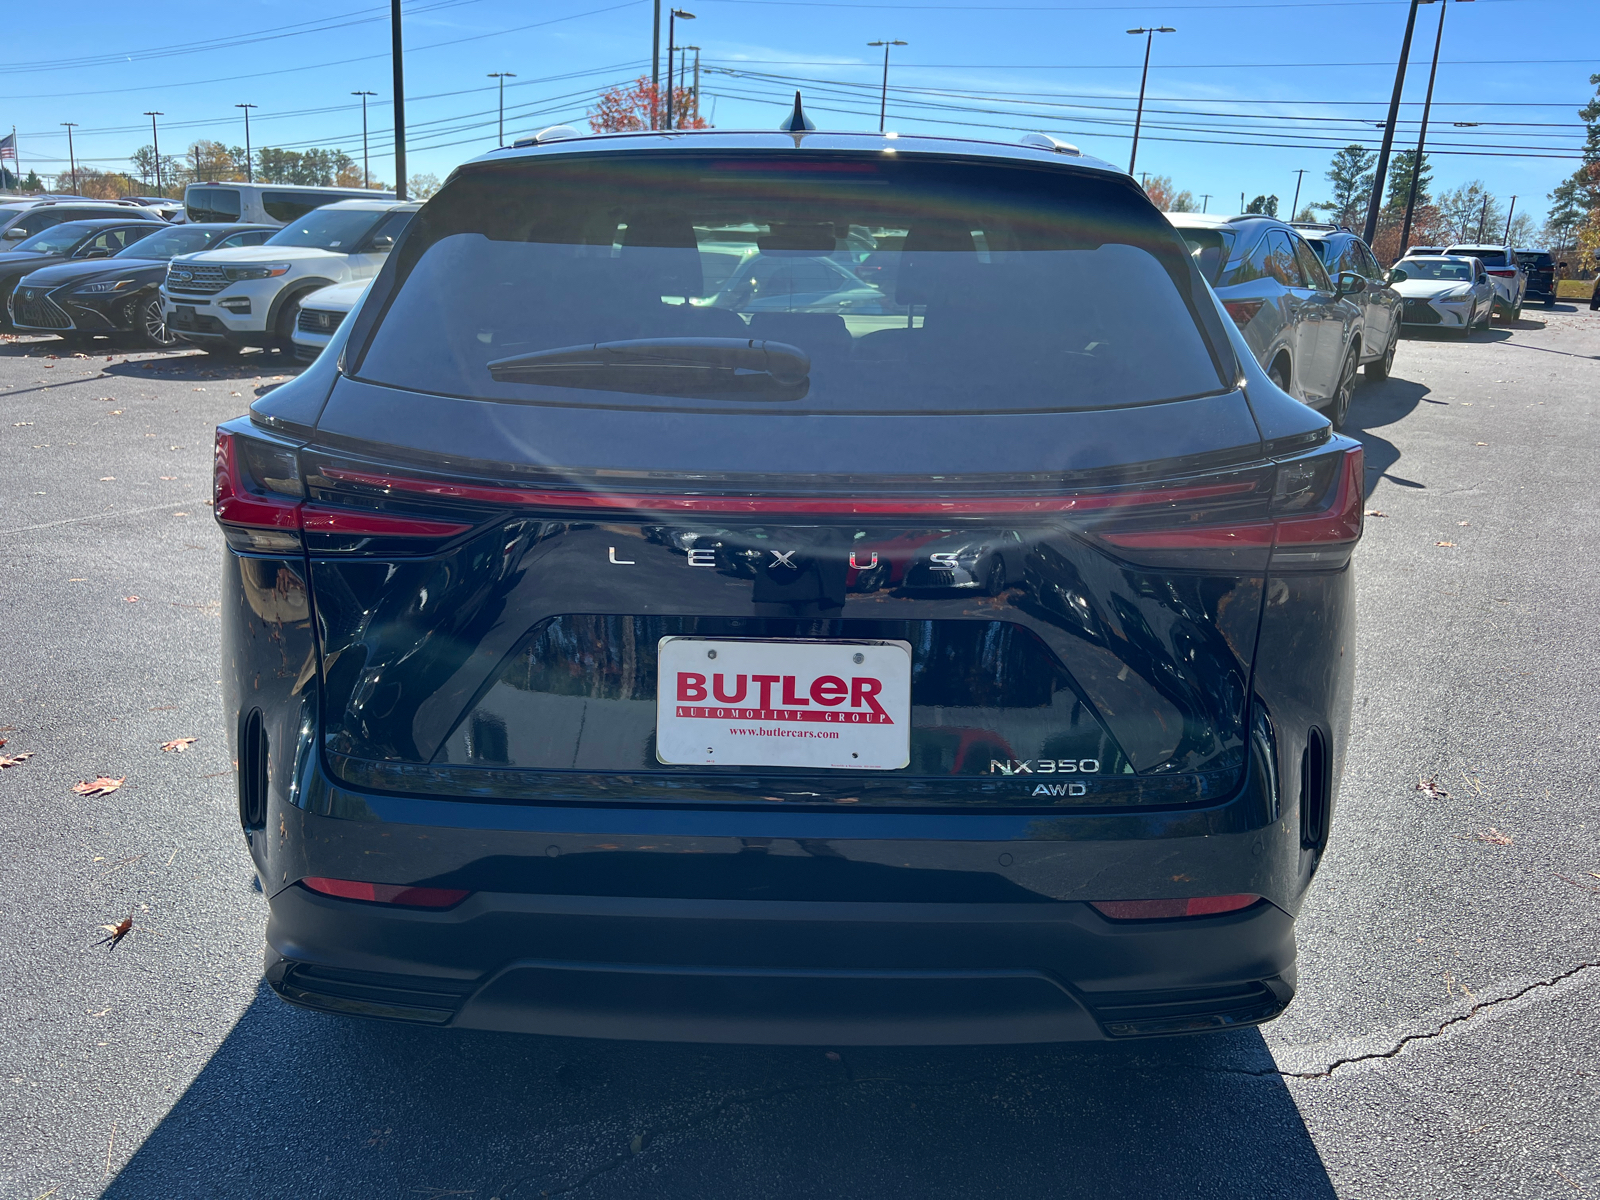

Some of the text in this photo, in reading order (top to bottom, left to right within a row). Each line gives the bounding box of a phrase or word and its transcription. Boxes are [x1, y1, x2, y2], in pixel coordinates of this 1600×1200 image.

[608, 546, 960, 571] LEXUS
[677, 707, 886, 723] AUTOMOTIVE GROUP
[729, 727, 839, 739] www.butlercars.com
[1032, 784, 1087, 796] AWD
